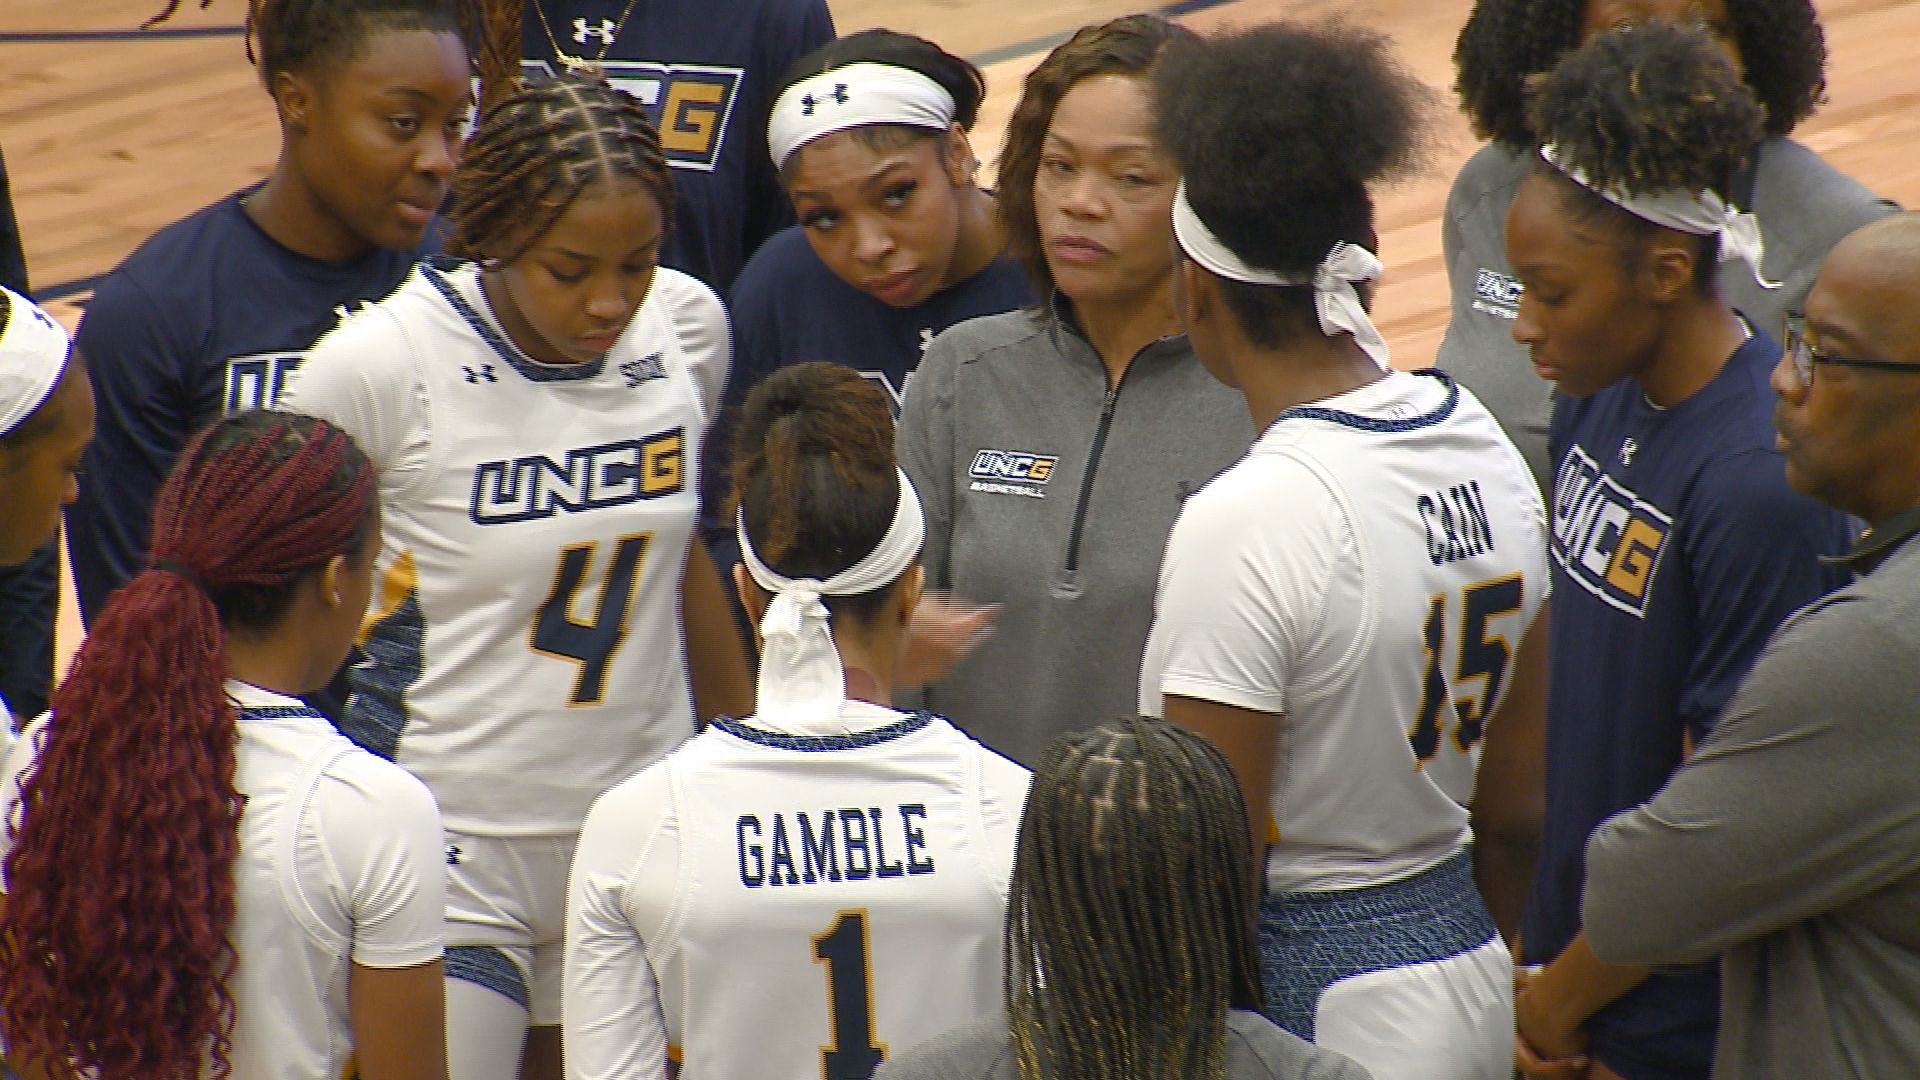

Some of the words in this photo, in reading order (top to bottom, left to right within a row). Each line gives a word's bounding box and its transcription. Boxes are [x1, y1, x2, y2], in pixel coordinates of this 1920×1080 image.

[1475, 269, 1526, 304] UNC
[471, 426, 686, 525] UNCG
[969, 450, 1058, 483] UNCG
[1417, 480, 1494, 566] CAIN
[1551, 452, 1670, 608] UNCG
[530, 531, 656, 707] 4
[1408, 570, 1524, 772] 15
[736, 803, 936, 888] GAMBLE
[810, 907, 889, 1080] 1
